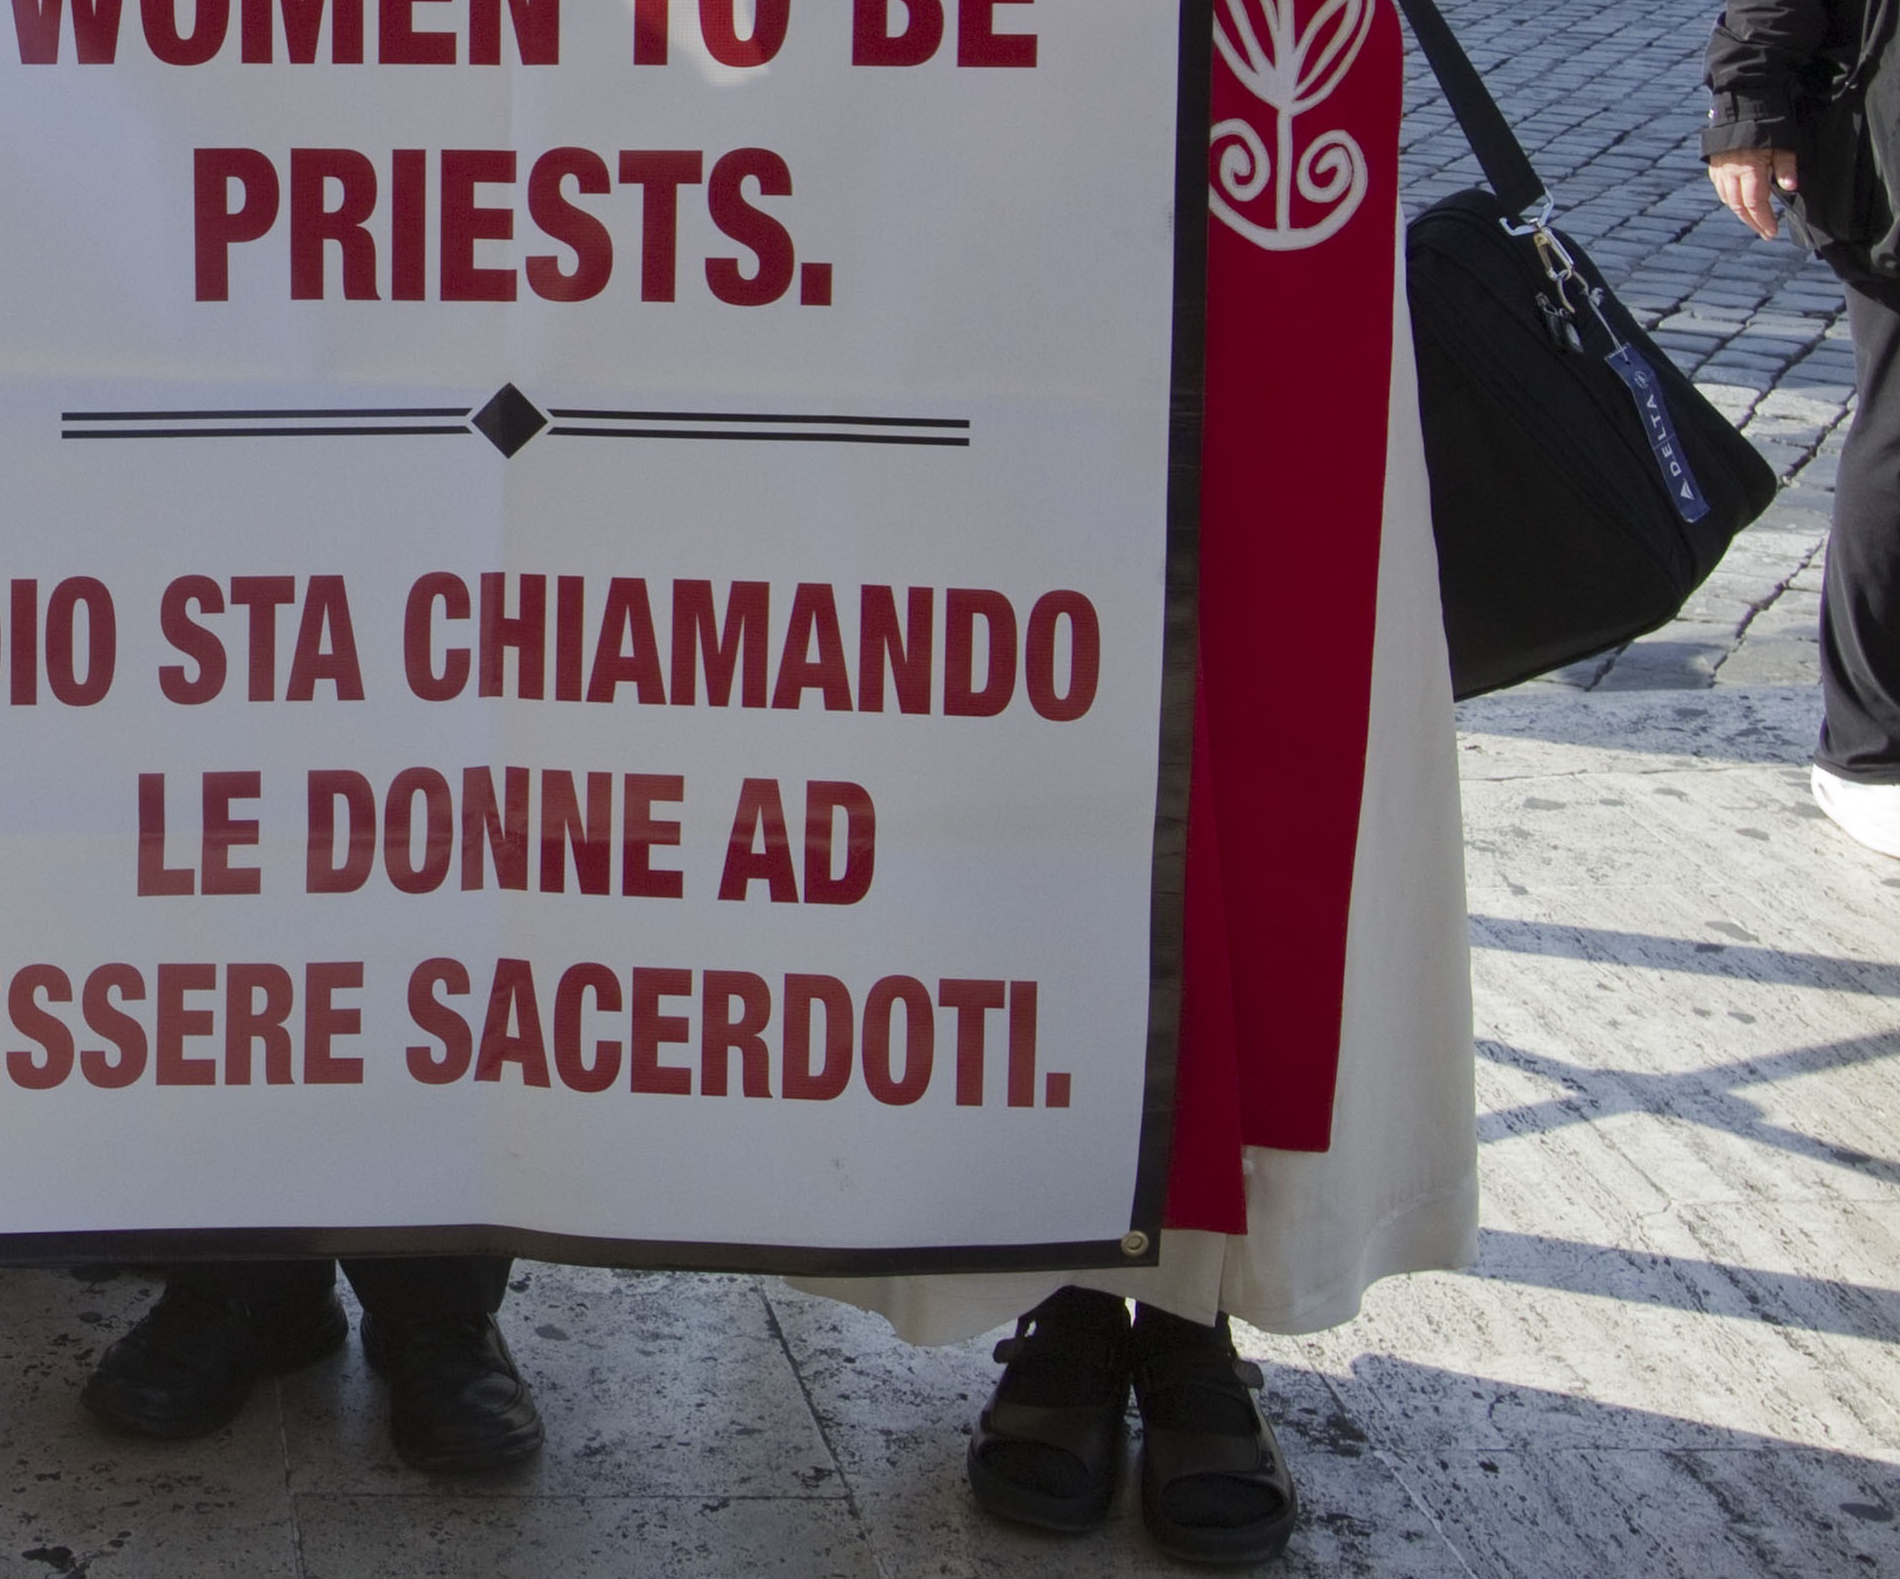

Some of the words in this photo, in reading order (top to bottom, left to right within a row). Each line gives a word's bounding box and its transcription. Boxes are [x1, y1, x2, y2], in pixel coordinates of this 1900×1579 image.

[195, 147, 831, 306] PRIESTS.
[1646, 394, 1682, 477] DELTA
[159, 571, 365, 705] STA
[403, 571, 1100, 722] CHIAMANDO
[138, 771, 261, 896] LE
[307, 766, 684, 899] DONNE
[718, 777, 876, 905] AD
[406, 957, 1071, 1108] SACERDOTI.
